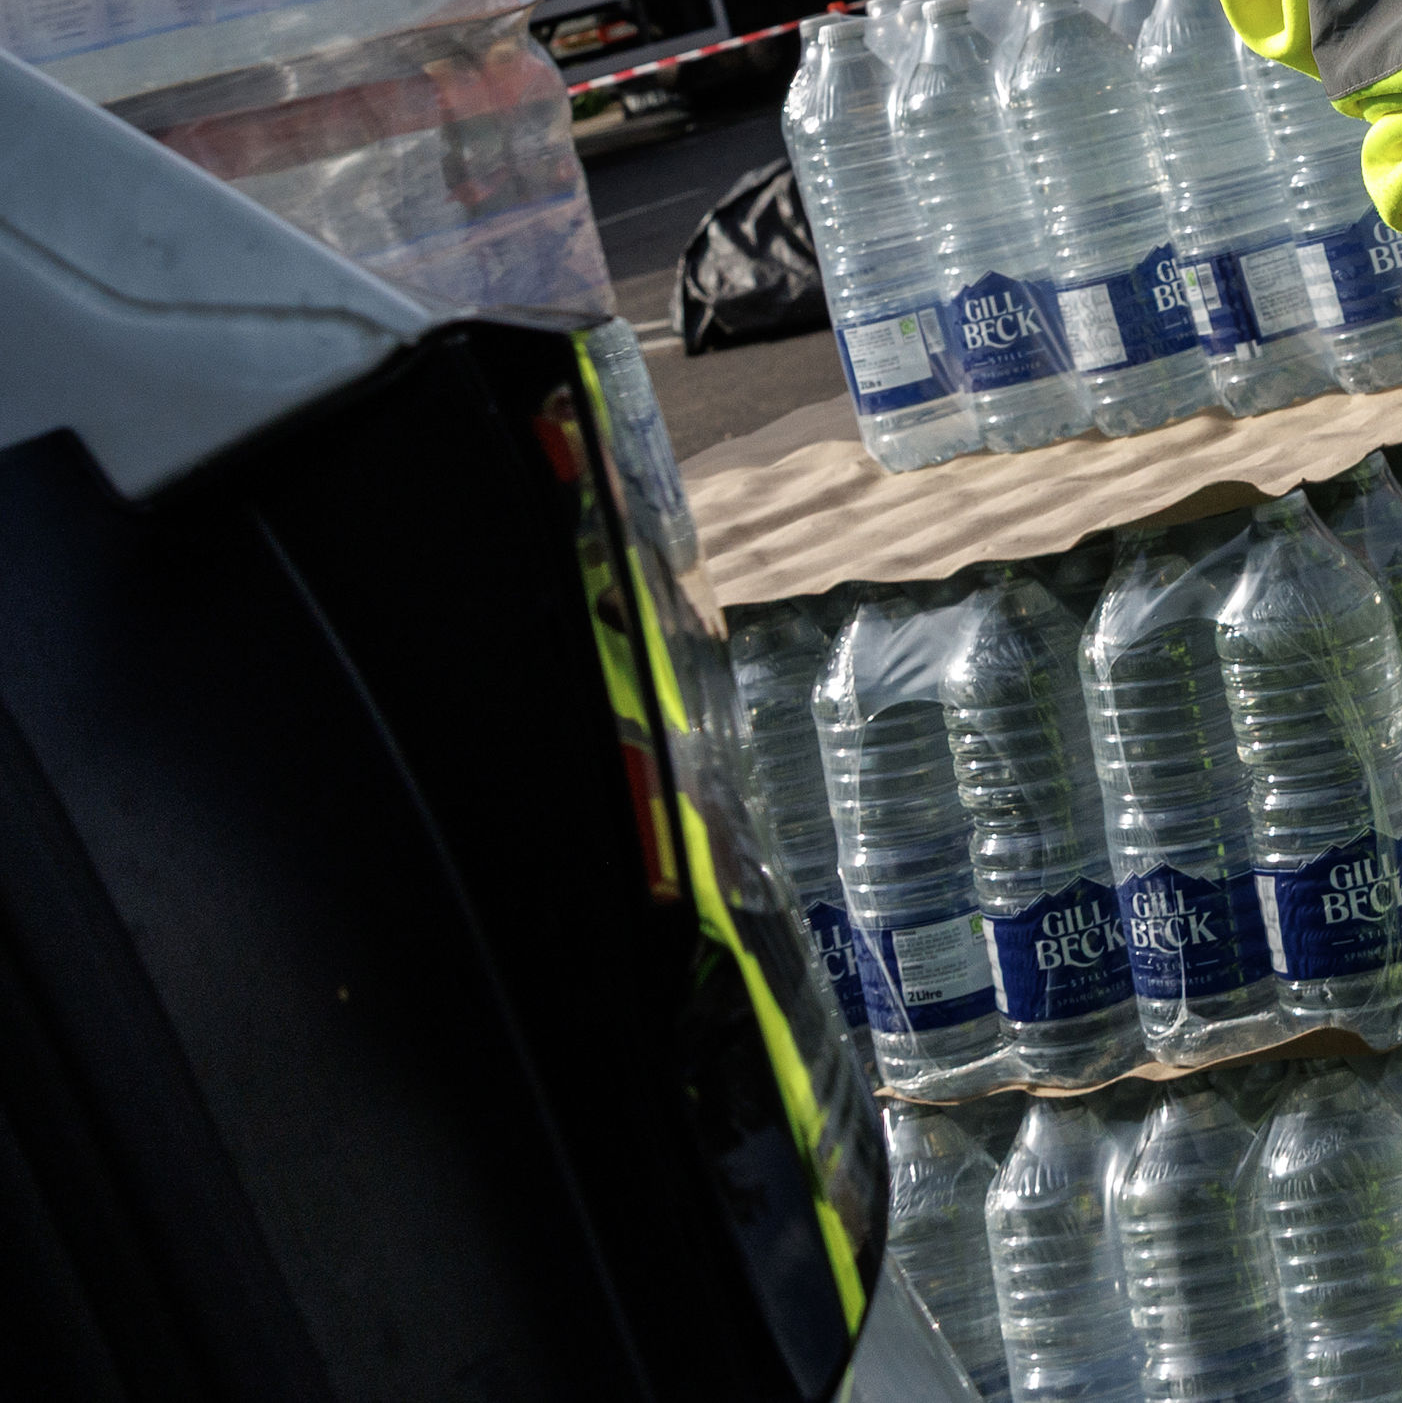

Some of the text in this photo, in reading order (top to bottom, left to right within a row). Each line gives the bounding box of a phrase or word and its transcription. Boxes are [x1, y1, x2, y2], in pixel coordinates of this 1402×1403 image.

[965, 291, 1023, 322] GILL
[962, 308, 1044, 350] BECK
[1330, 854, 1400, 890] GILL
[1042, 900, 1111, 937] GILL
[1132, 889, 1197, 918] GILL
[1035, 917, 1128, 971] BECK
[1131, 911, 1218, 955] BECK
[907, 989, 943, 1002] 2 Litre
[1070, 970, 1108, 988] STILL
